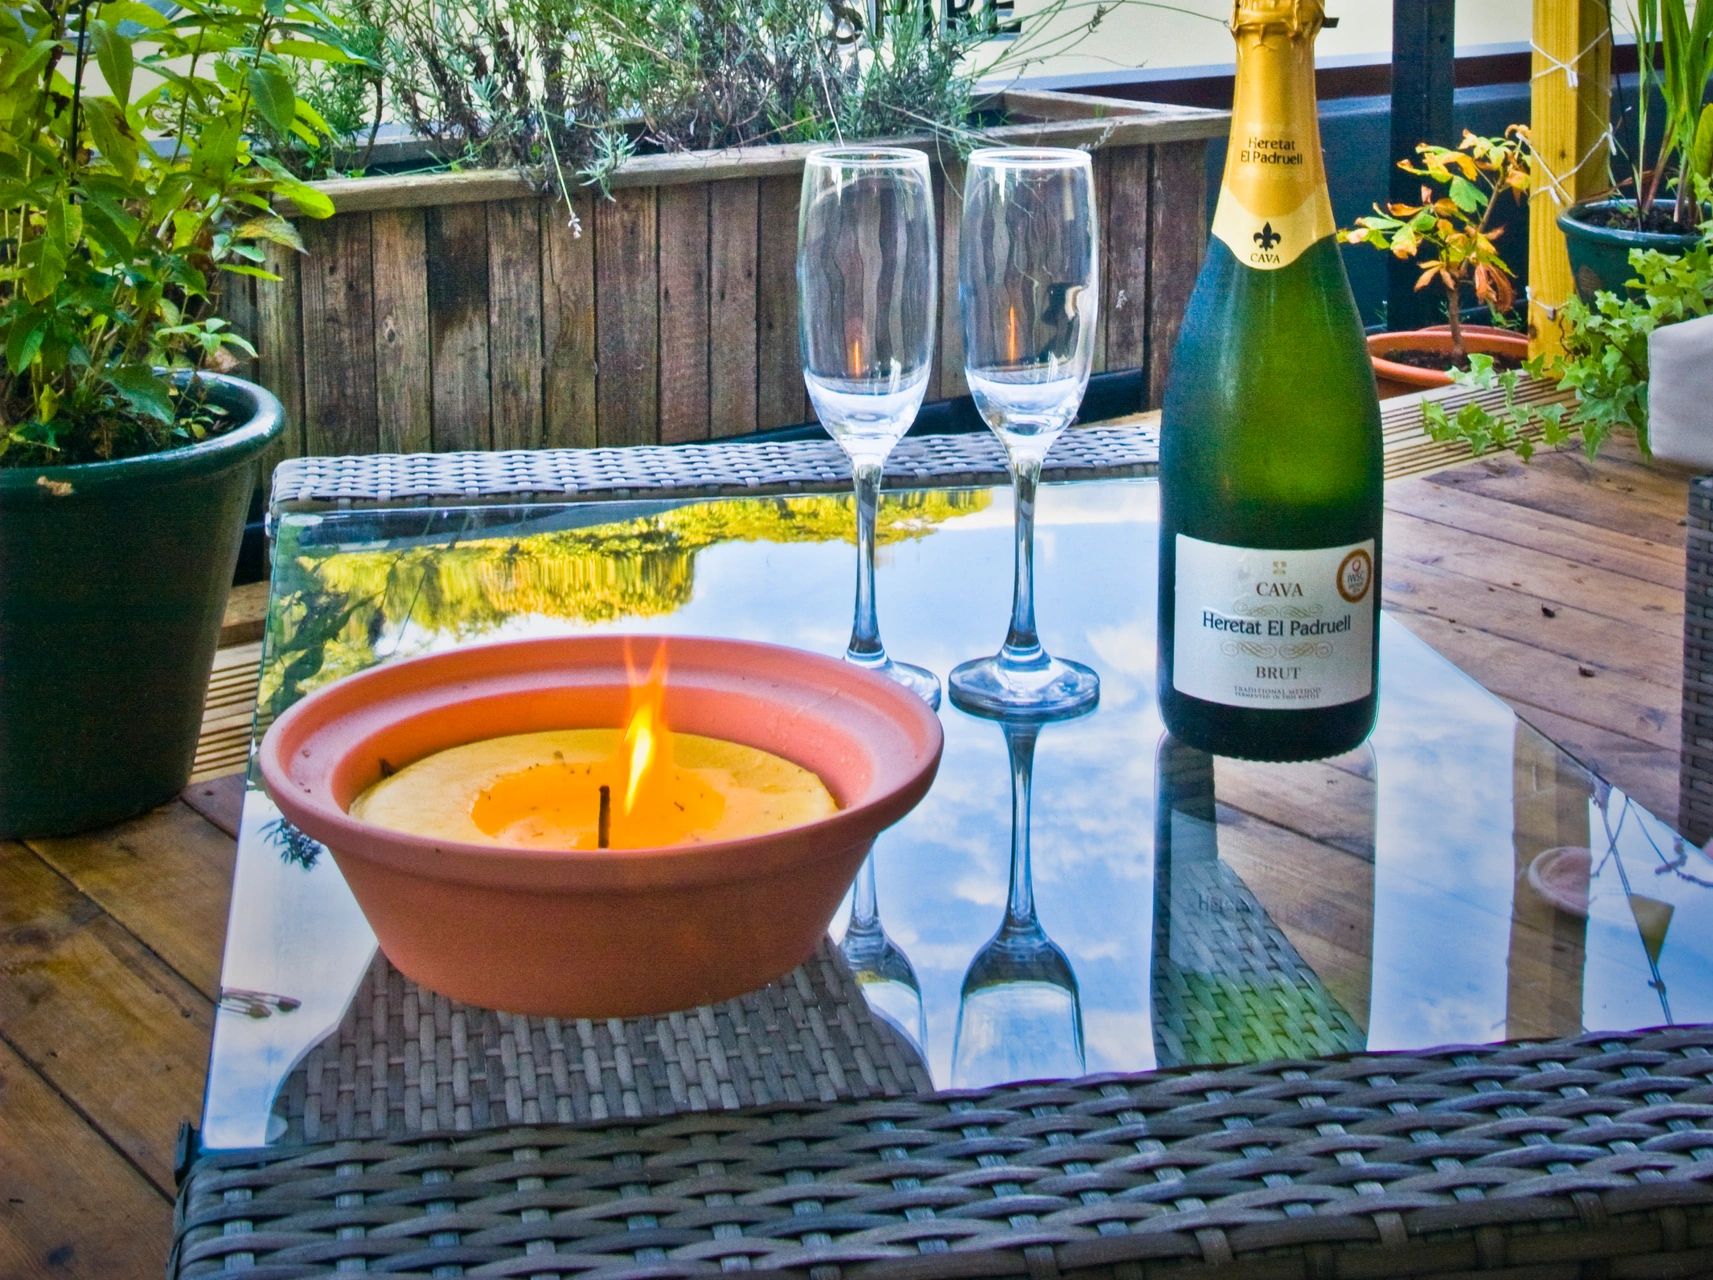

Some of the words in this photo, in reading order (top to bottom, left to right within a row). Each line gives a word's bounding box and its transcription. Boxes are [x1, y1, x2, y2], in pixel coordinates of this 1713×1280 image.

[1248, 136, 1295, 151] Heretat
[1240, 150, 1250, 163] El
[1252, 150, 1303, 165] Padruell
[1250, 253, 1280, 264] CAVA
[1256, 581, 1304, 597] CAVA
[1203, 610, 1262, 635] Heretat
[1267, 620, 1284, 637] El
[1290, 614, 1351, 636] Padruell
[1256, 665, 1301, 680] BRUT
